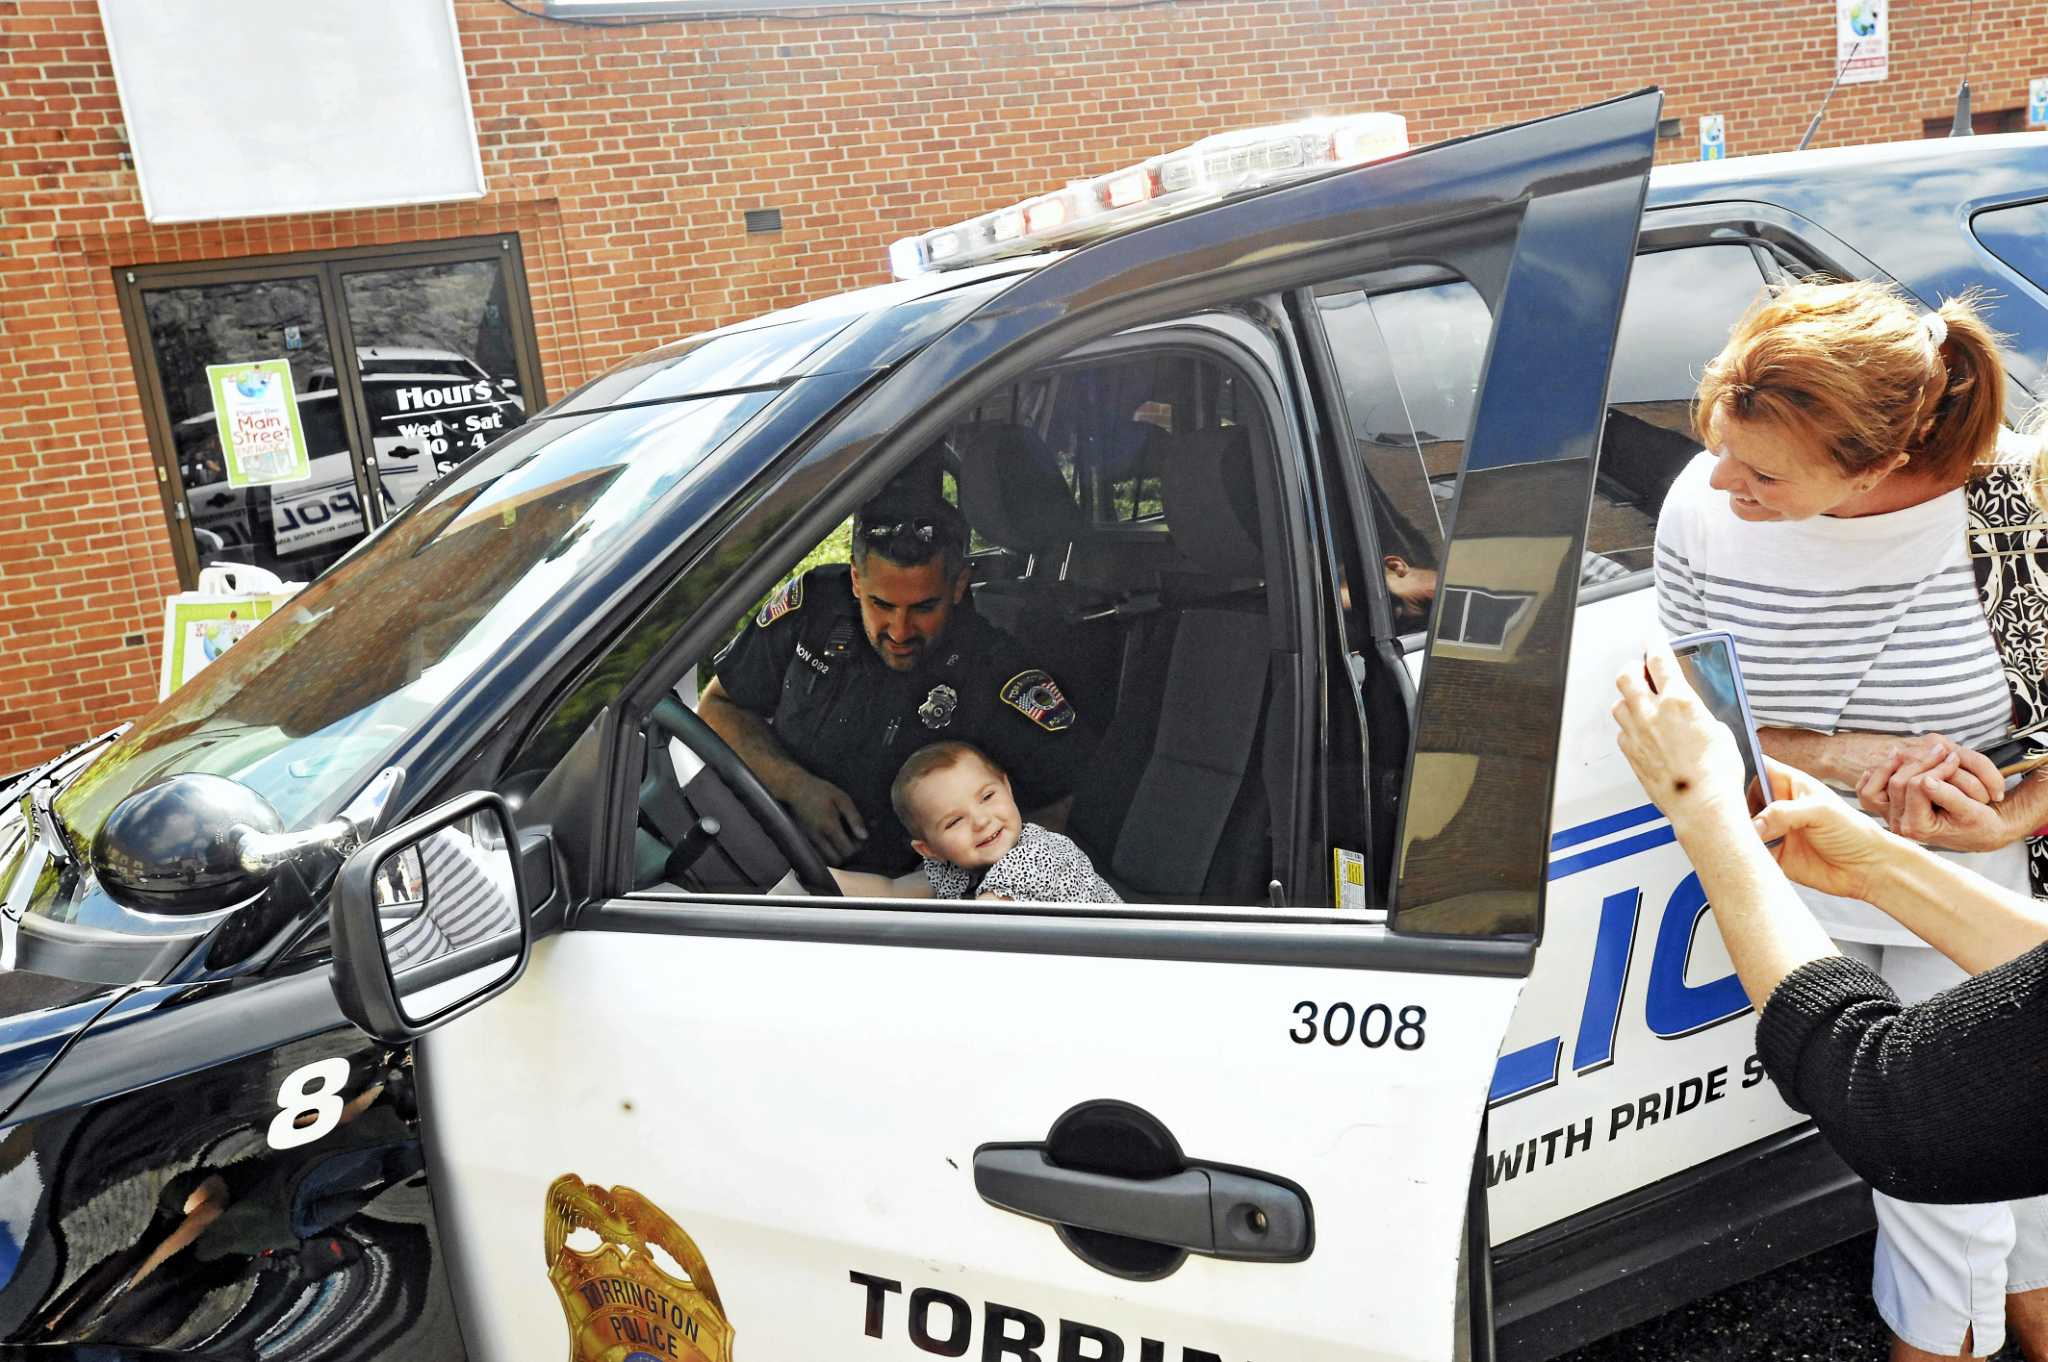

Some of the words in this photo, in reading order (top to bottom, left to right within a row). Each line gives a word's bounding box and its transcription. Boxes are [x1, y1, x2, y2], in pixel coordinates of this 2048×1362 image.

[395, 379, 492, 411] Hours
[232, 425, 290, 446] Street
[238, 416, 280, 432] Main
[397, 420, 444, 440] Wed
[465, 411, 503, 432] Sat
[422, 438, 448, 455] 10
[471, 432, 487, 449] 4
[1288, 1000, 1428, 1051] 3008
[266, 1057, 351, 1150] 8
[1486, 1116, 1593, 1188] WITH
[1608, 1066, 1728, 1141] PRIDE
[1742, 1052, 1768, 1089] S
[579, 1278, 699, 1343] TORRINGTON
[609, 1315, 678, 1359] POLICE
